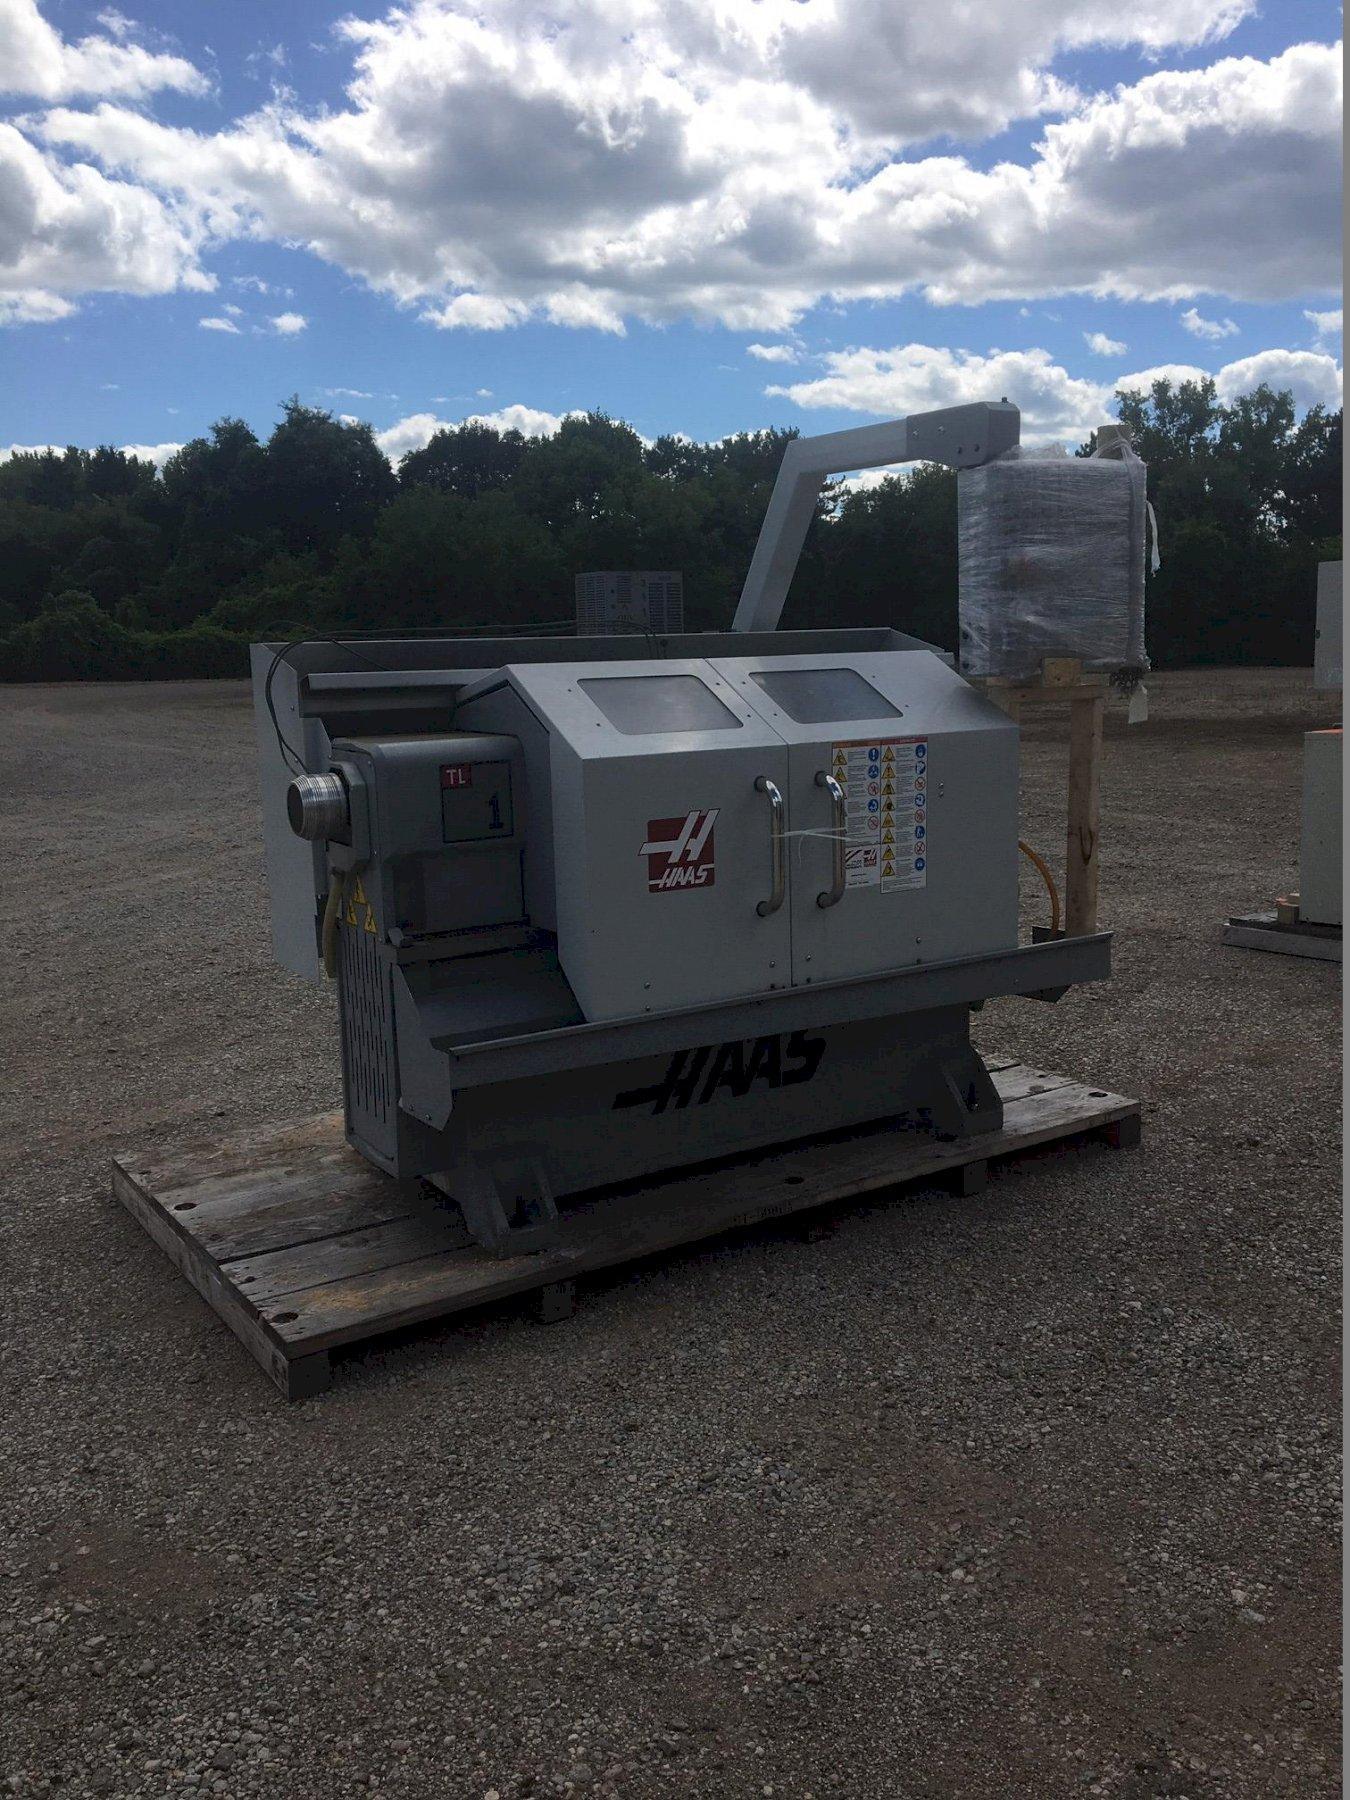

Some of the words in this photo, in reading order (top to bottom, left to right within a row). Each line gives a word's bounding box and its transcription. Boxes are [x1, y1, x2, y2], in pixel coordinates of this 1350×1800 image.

[446, 768, 466, 785] TL
[489, 796, 504, 829] 1
[649, 863, 715, 889] HAAS
[613, 1029, 826, 1115] HAAS
